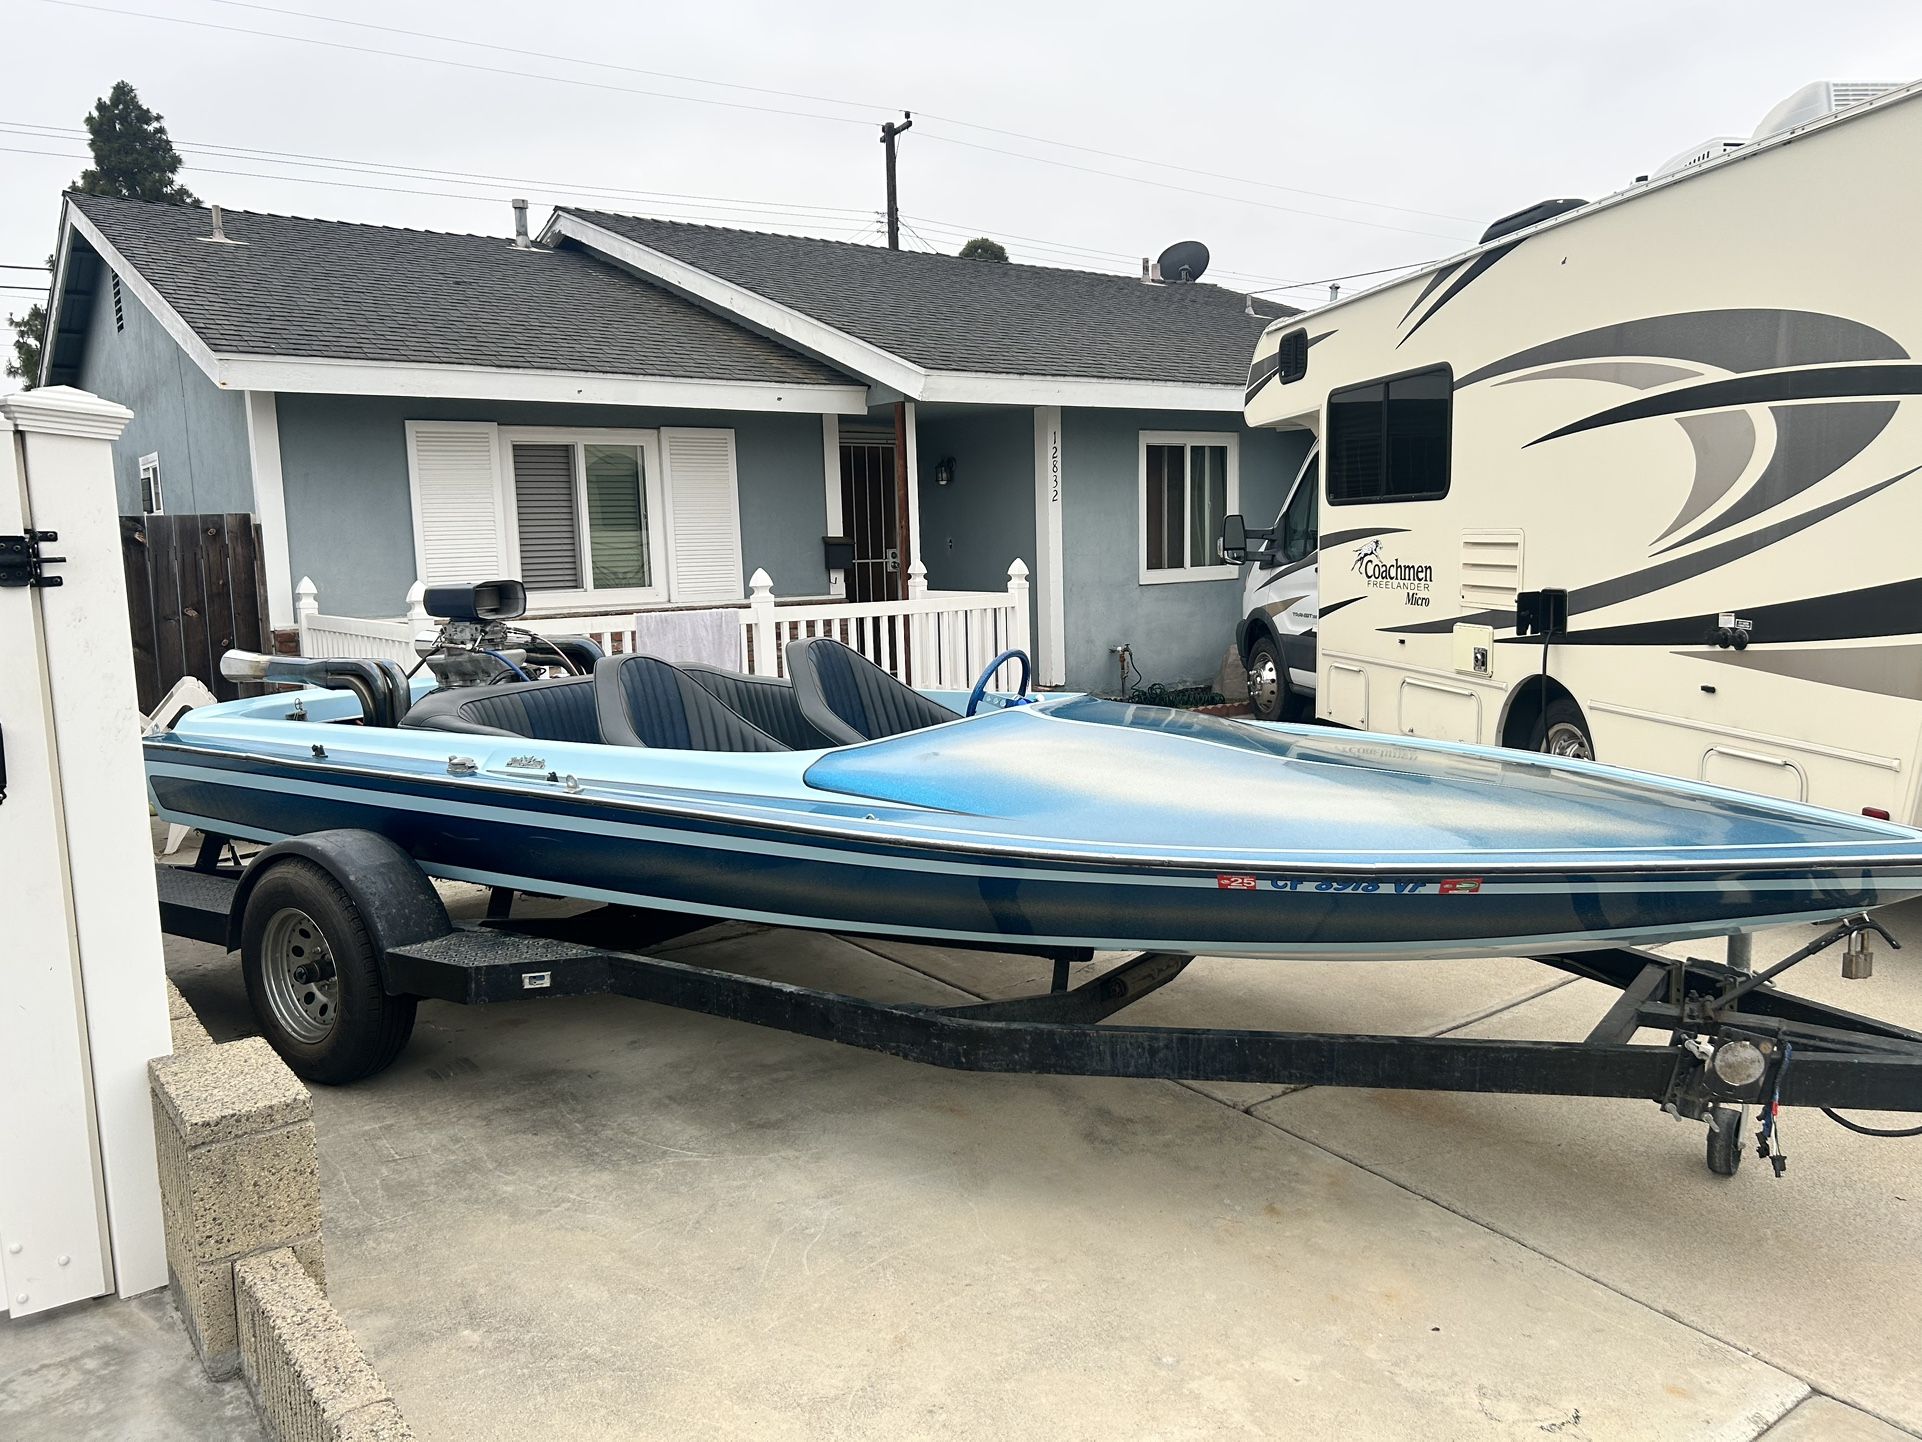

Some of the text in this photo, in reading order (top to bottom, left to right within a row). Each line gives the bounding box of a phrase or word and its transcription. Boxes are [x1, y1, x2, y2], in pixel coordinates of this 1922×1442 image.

[1365, 558, 1433, 582] Coachmen
[1367, 580, 1430, 592] FREELANDER
[1405, 592, 1430, 607] Micro
[1230, 878, 1255, 887] 25
[1271, 876, 1305, 890] CF
